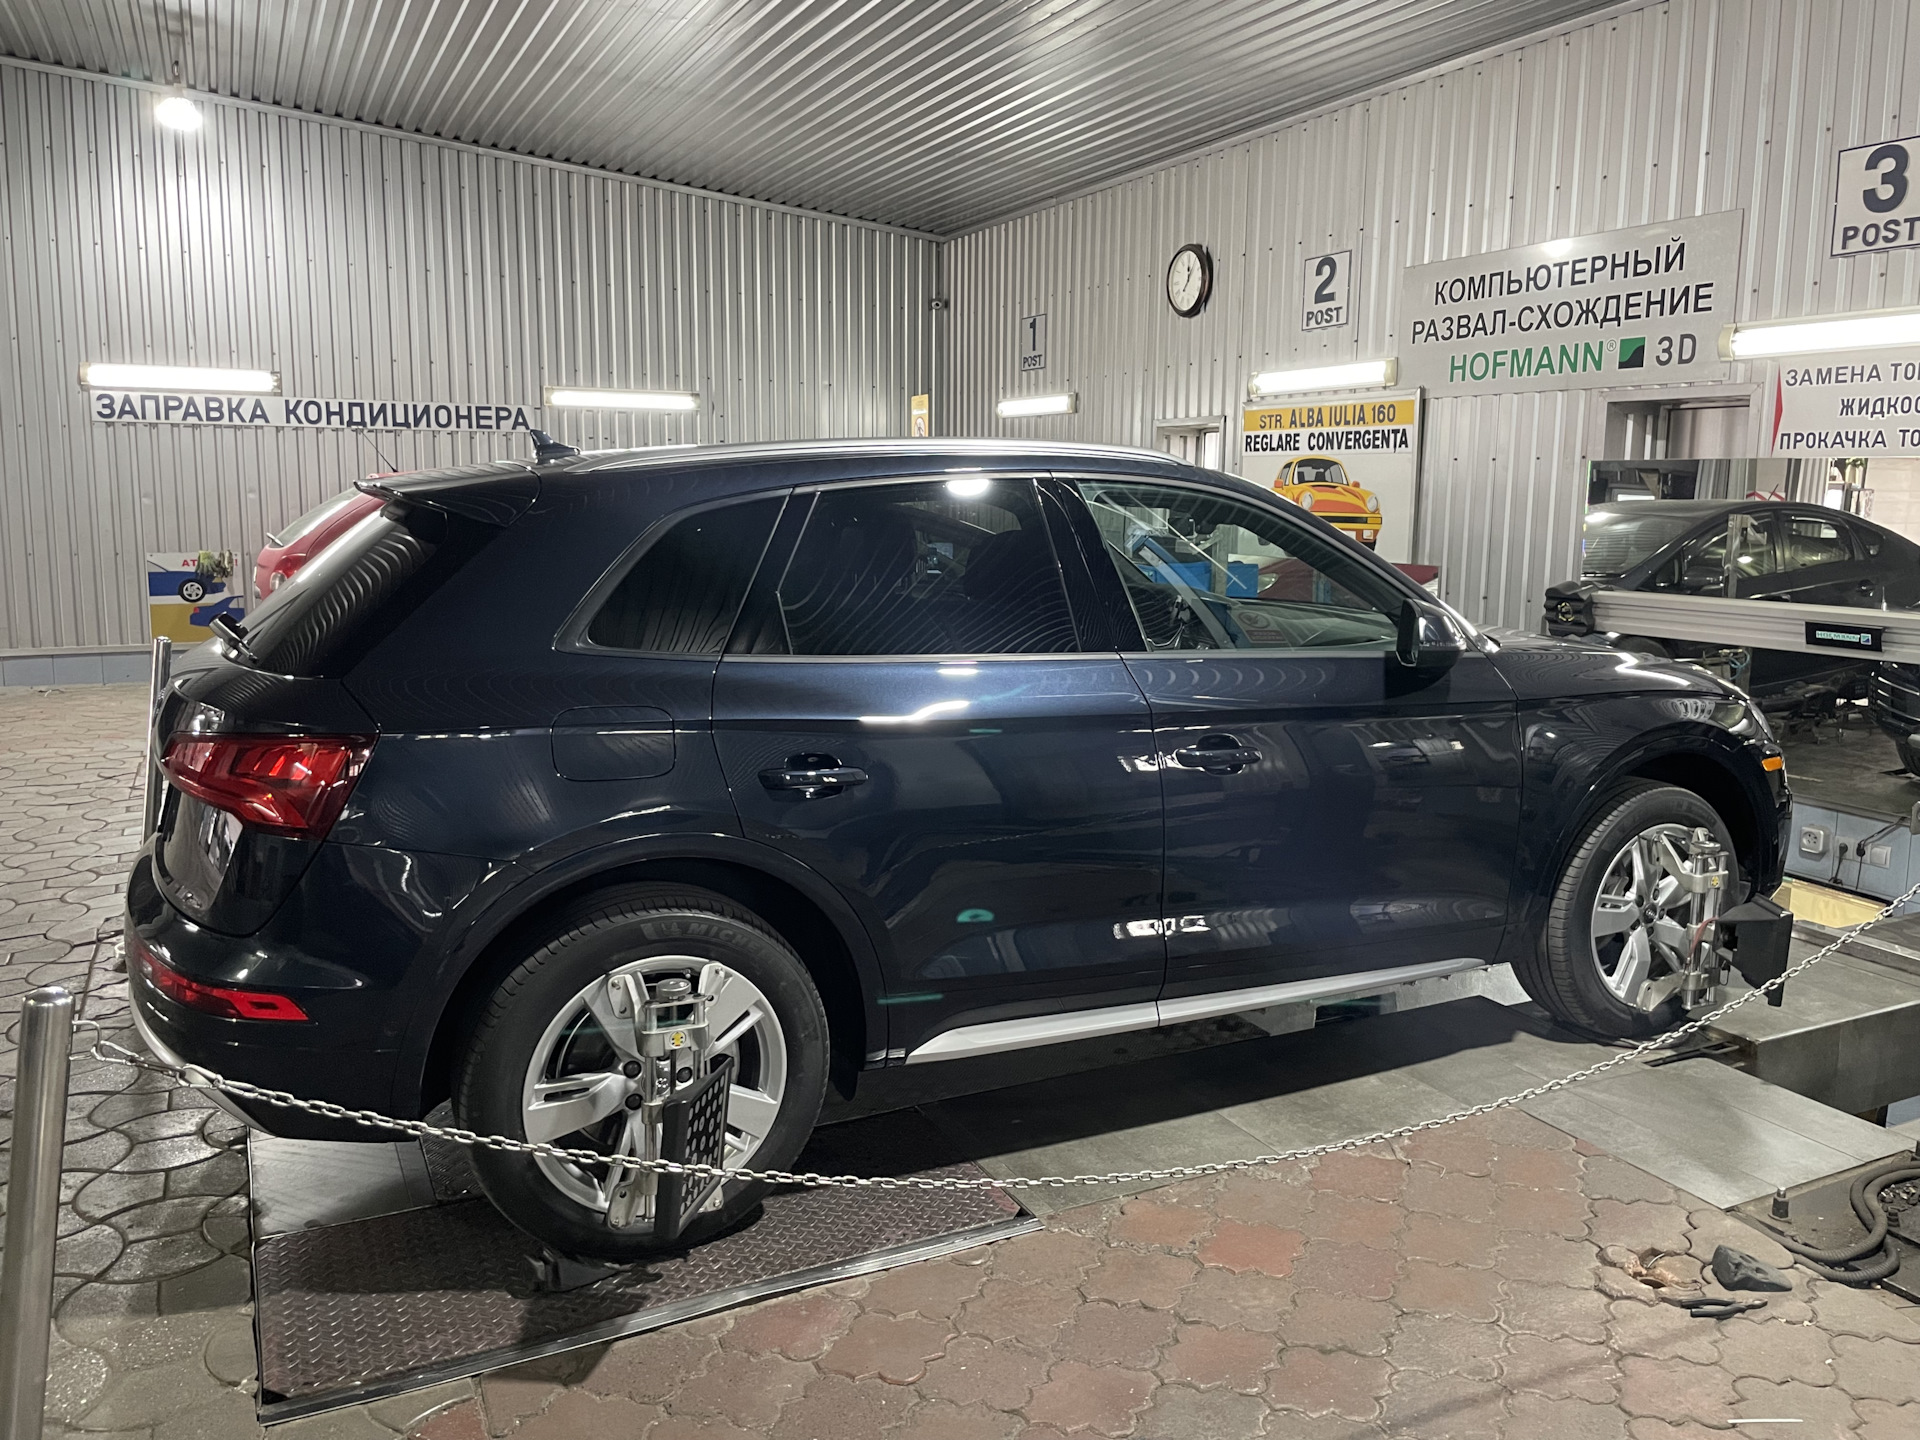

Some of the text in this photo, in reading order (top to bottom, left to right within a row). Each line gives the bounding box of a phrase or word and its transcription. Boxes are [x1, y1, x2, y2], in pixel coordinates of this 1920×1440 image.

[1863, 144, 1909, 213] 3
[1841, 217, 1920, 250] POST
[1314, 256, 1337, 305] 2
[1433, 235, 1686, 306] КОМПЬЮТЕРНЫЙ
[1306, 306, 1343, 327] POST
[1411, 282, 1714, 345] РАЗВАЛ-СХОЖДЕНИЕ
[1029, 317, 1037, 351] 1
[1655, 333, 1697, 367] 3D
[1022, 354, 1043, 369] POST
[1785, 362, 1920, 387] ЗАМЕНА ТО
[96, 393, 532, 431] ЗАПРАВКА КОНДИЦИОНЕРА
[1259, 413, 1285, 430] STR.
[1289, 408, 1325, 429] ALBA
[1371, 403, 1397, 424] 160
[1245, 433, 1300, 452] REGLARE
[1779, 430, 1887, 450] ПРОКАЧКА
